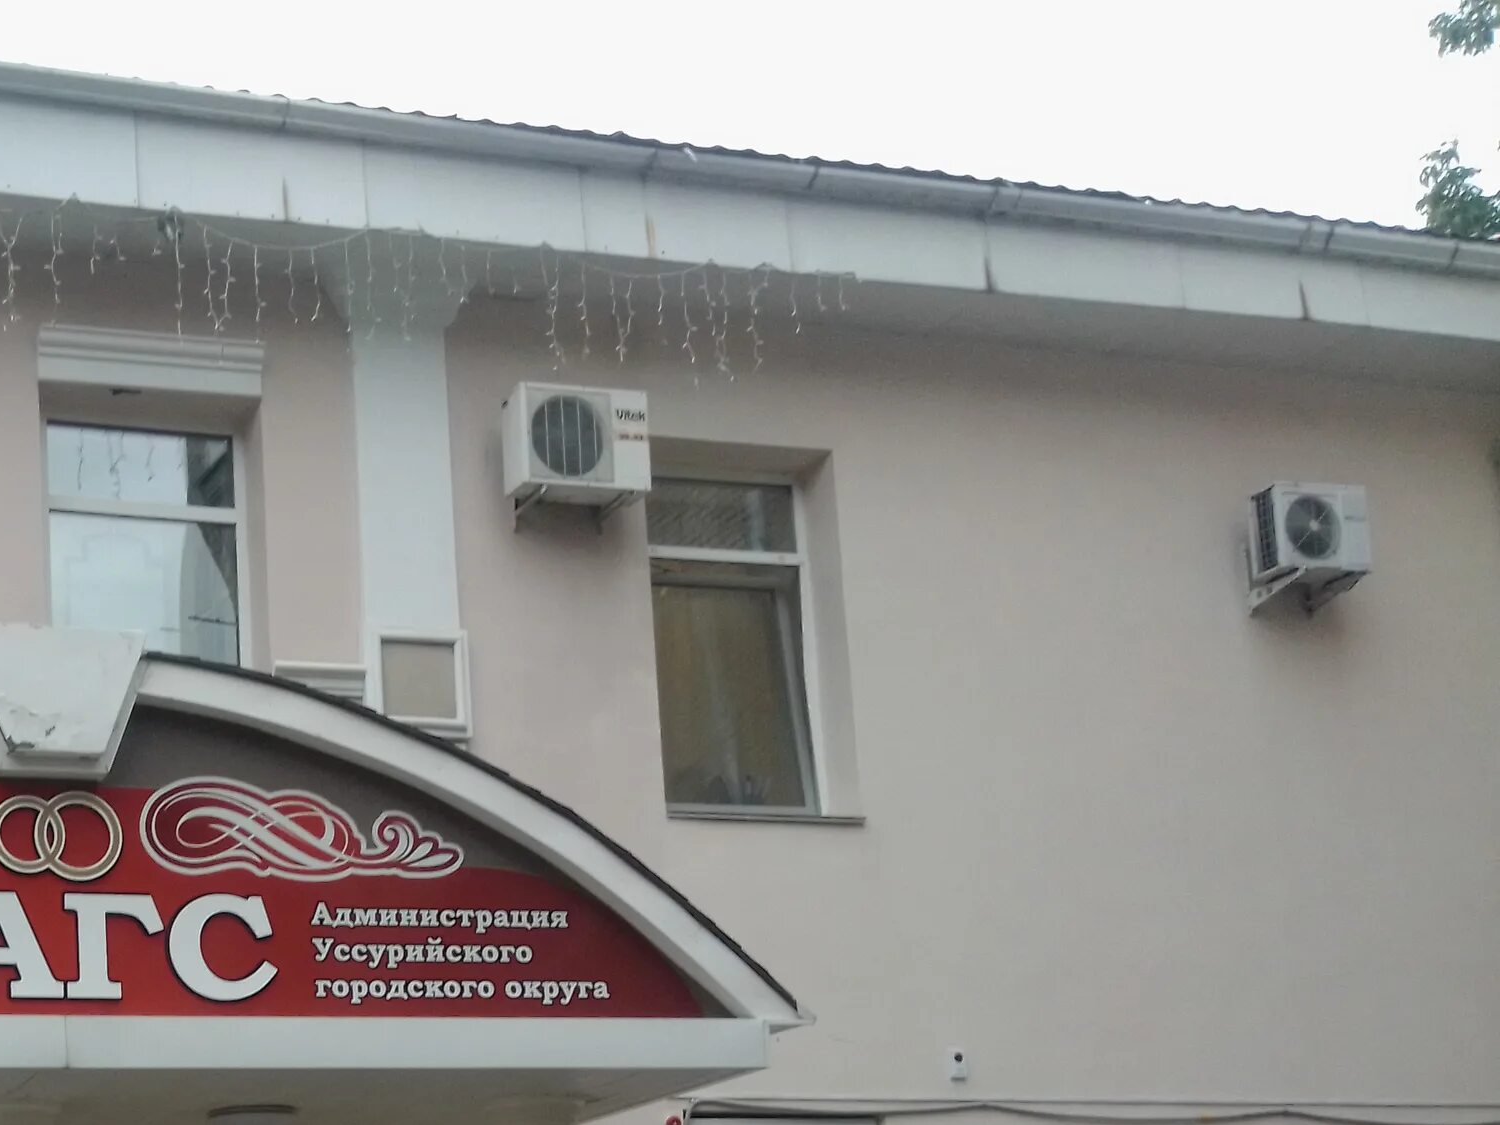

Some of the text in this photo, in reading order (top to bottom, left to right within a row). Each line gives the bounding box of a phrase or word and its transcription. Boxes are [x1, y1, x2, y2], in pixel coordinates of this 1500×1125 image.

[311, 901, 569, 933] Администрация
[311, 936, 533, 969] Уссурийского
[314, 979, 611, 1006] городского округа
